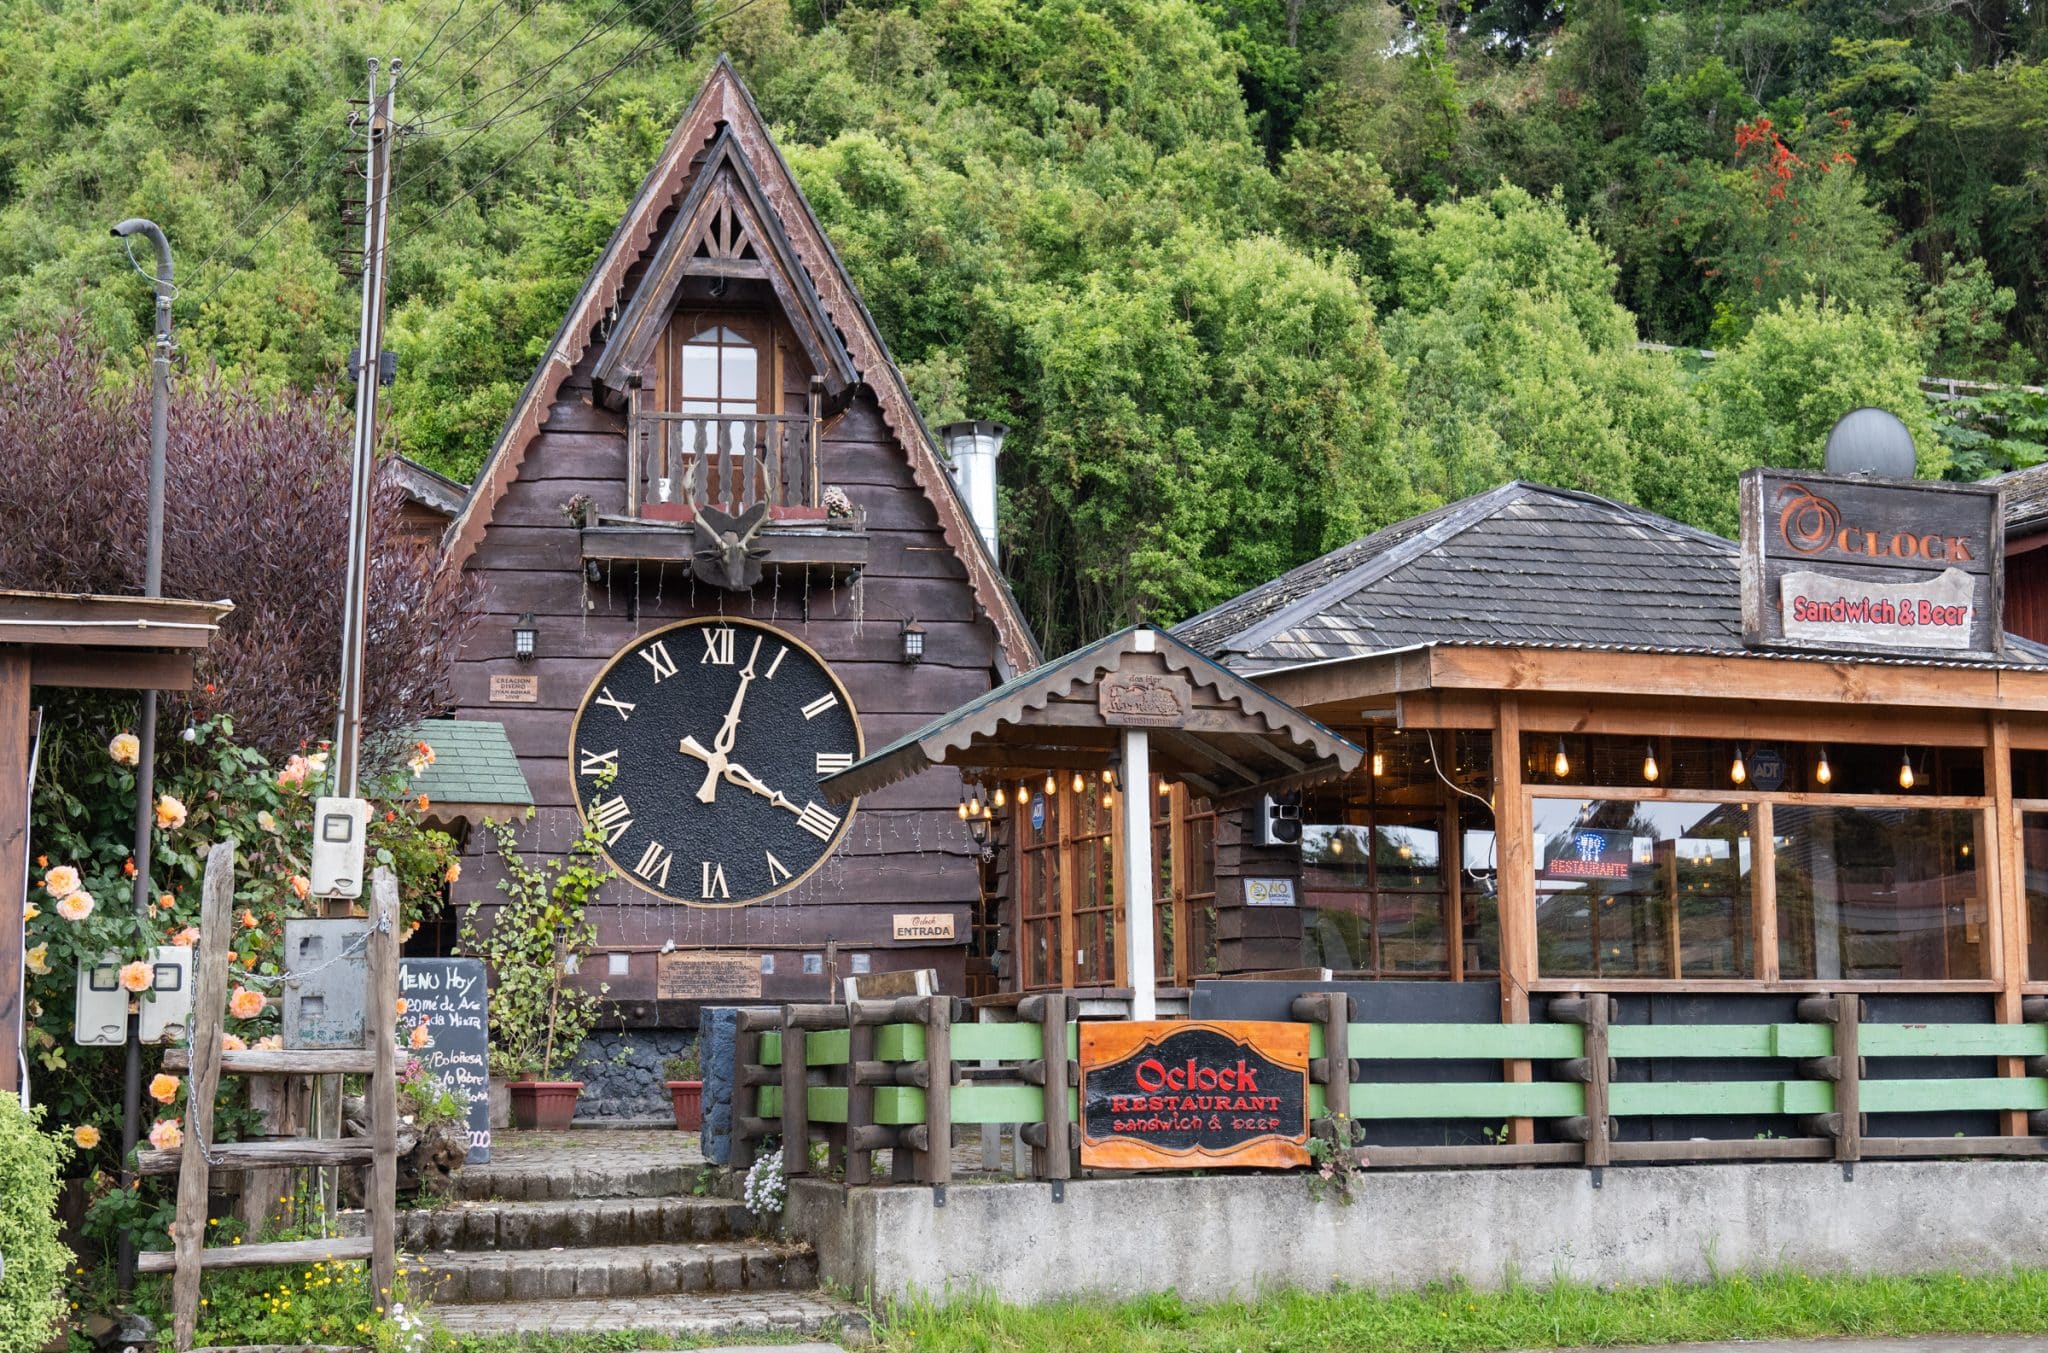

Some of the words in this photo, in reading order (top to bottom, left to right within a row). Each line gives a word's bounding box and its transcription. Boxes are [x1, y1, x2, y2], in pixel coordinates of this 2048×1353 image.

[1794, 595, 1896, 625] Sandwich
[1898, 599, 1915, 626] &
[1918, 600, 1967, 626] Beer
[638, 640, 679, 683] XI
[701, 628, 736, 665] XII
[765, 646, 788, 679] I
[595, 686, 636, 721] X
[801, 691, 838, 720] II
[1755, 763, 1779, 777] ADT
[634, 841, 673, 888] VII
[702, 862, 730, 898] VI
[766, 850, 792, 886] V
[1551, 860, 1628, 877] RESTAURANTE
[897, 927, 951, 936] ENTRADA
[446, 966, 477, 997] Hoy
[440, 995, 455, 1012] de
[1135, 1058, 1258, 1093] Oclock
[1111, 1096, 1281, 1113] RESTAURANT
[1112, 1111, 1203, 1132] sandwich
[1208, 1114, 1222, 1131] &
